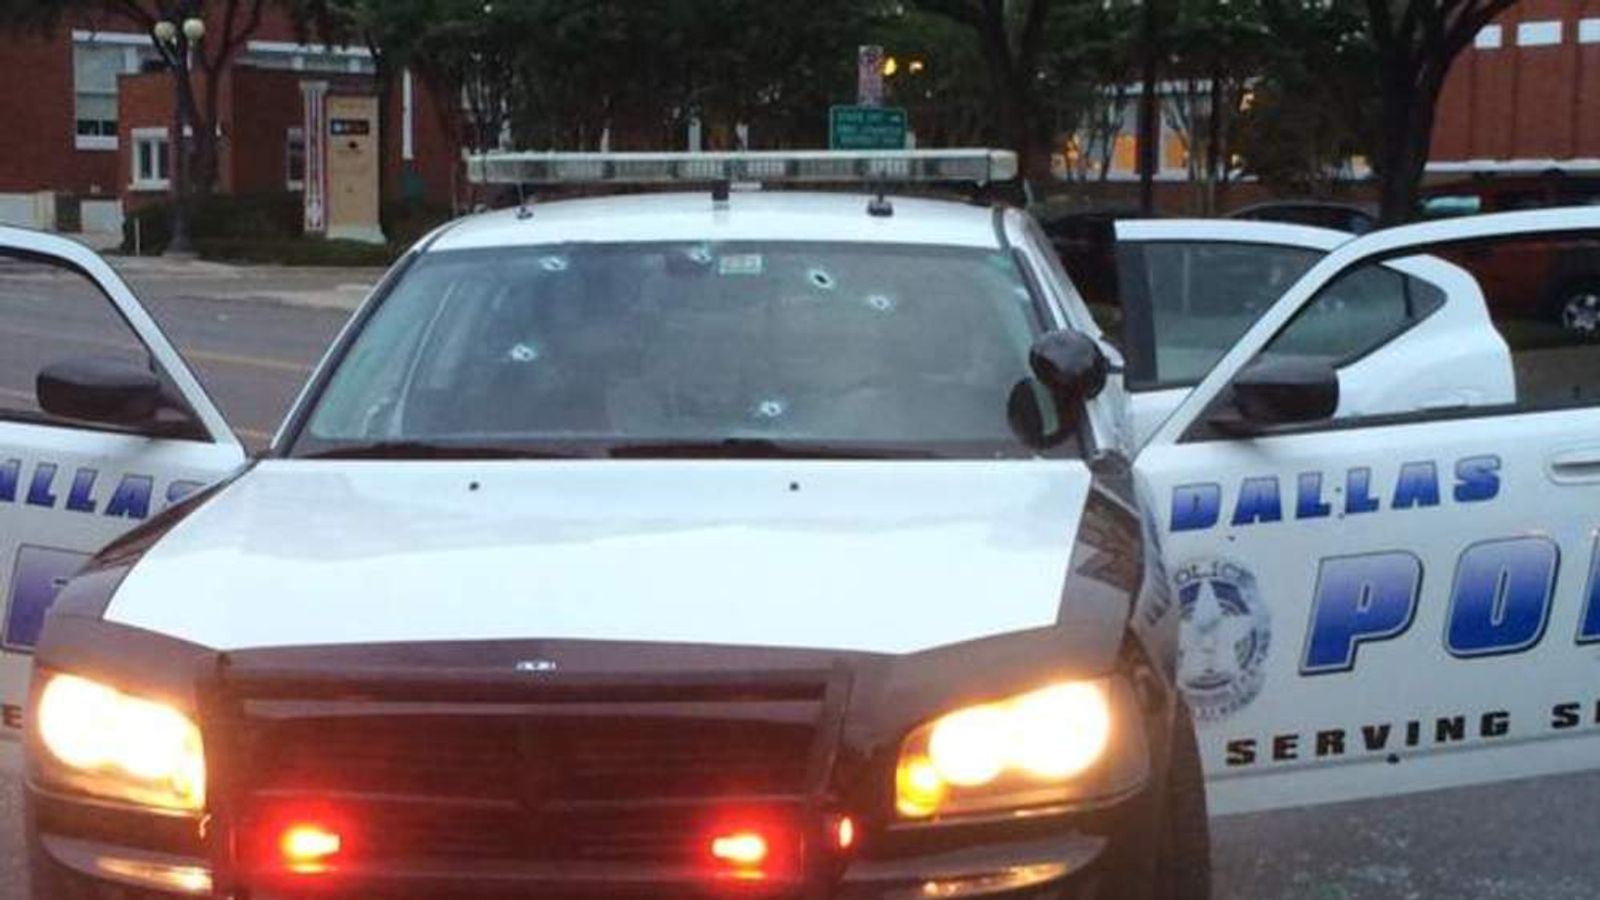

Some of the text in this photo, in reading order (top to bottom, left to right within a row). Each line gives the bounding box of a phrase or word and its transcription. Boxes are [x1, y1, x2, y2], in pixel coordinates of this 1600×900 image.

[1170, 455, 1501, 531] DALLAS
[1300, 534, 1600, 675] PO
[1226, 701, 1600, 765] SERVING S
